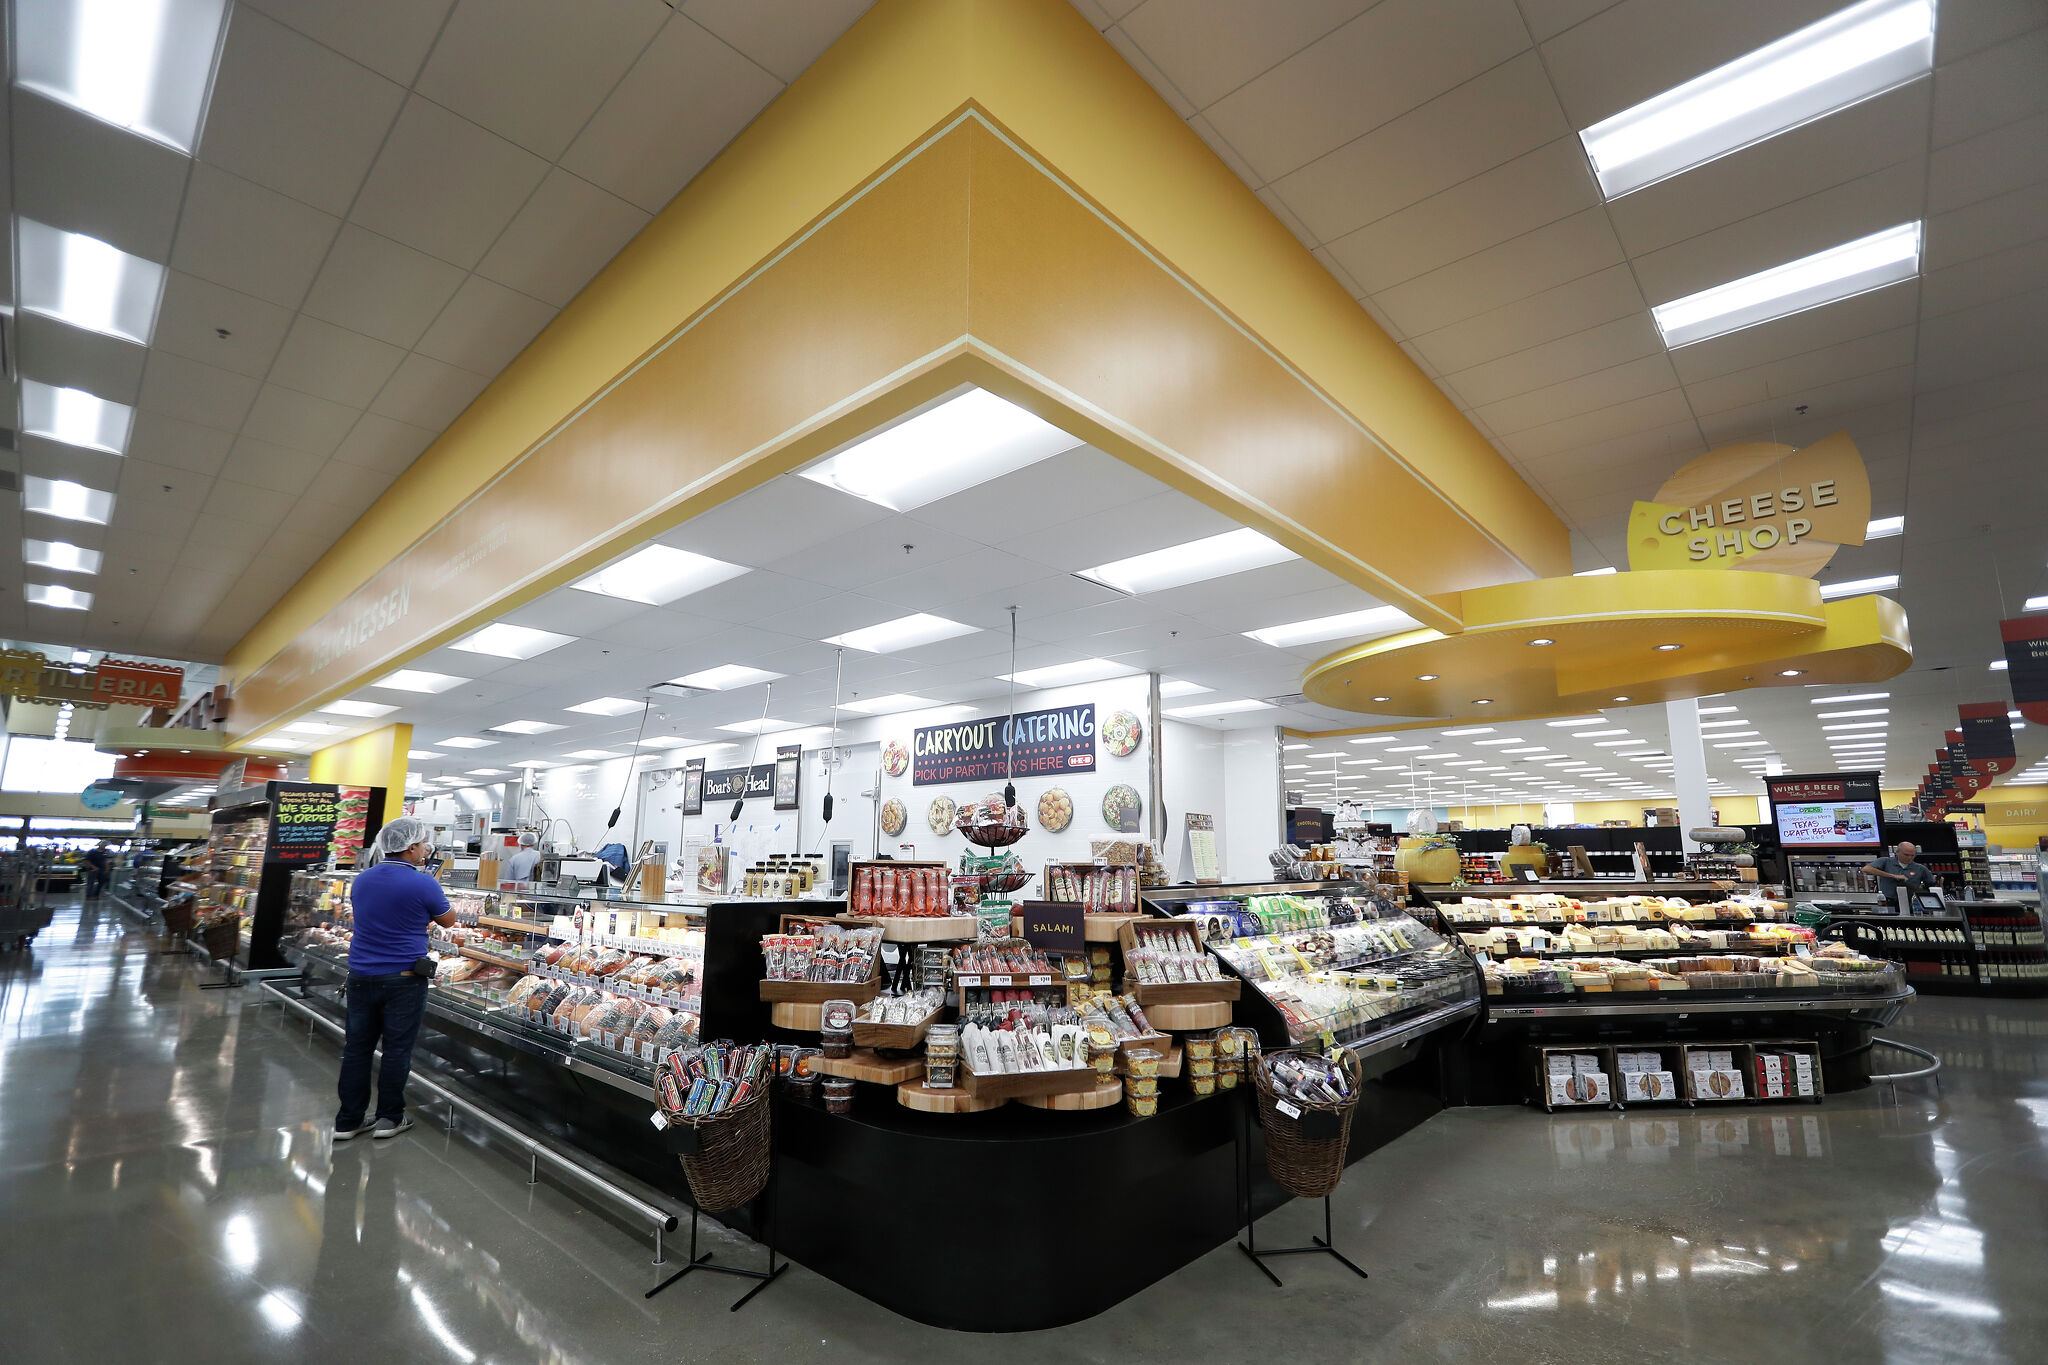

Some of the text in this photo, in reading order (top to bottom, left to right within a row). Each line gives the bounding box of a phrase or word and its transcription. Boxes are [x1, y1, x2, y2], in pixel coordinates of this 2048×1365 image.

[1659, 479, 1840, 536] CHEESE
[1687, 518, 1813, 561] SHOP
[0, 666, 168, 698] RTILLERIA
[915, 707, 1094, 757] CARRYOUT CATERING
[914, 769, 937, 782] PICK
[939, 767, 953, 780] UP
[955, 762, 989, 779] PARTY
[992, 759, 1027, 775] TRAYS
[1030, 755, 1064, 771] HERE
[1987, 761, 1999, 773] 2
[706, 772, 770, 795] Boar's Head
[1774, 784, 1800, 793] WINE
[1968, 778, 1979, 788] 3
[1954, 791, 1964, 799] 4
[279, 804, 335, 813] WE SLICE
[2006, 809, 2037, 817] DAIRY
[276, 813, 336, 824] TO ORDER
[1792, 820, 1820, 828] TEXAS
[1783, 826, 1833, 838] CRAFT BEER
[1033, 922, 1074, 935] SALAMI
